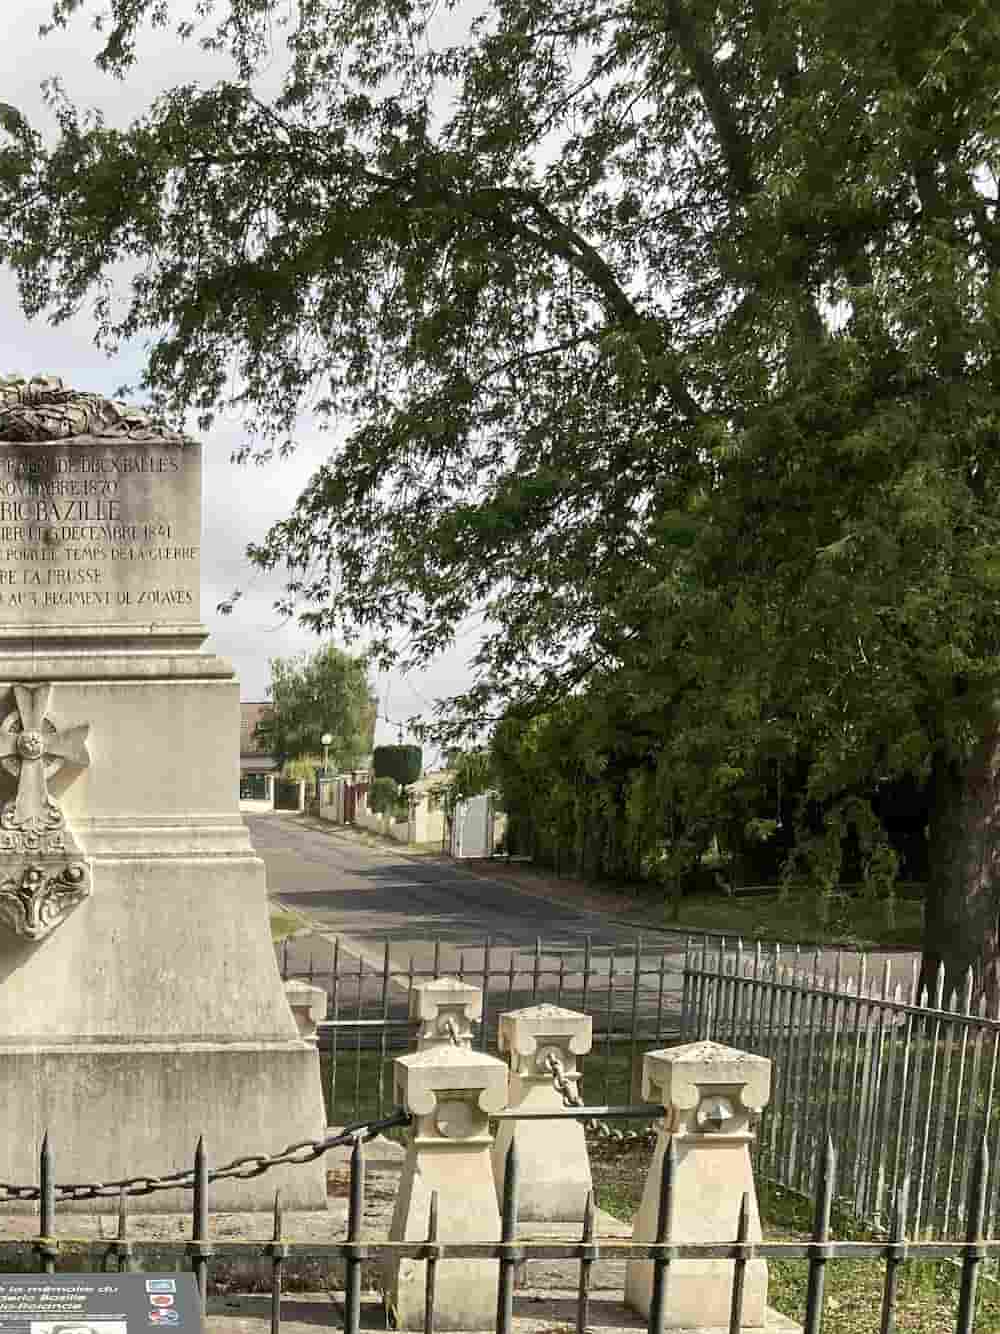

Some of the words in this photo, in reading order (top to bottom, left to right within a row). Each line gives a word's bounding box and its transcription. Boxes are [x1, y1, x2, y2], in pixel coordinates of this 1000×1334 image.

[35, 501, 121, 521] BAZILLE
[47, 567, 106, 585] PRUSSE
[98, 1285, 119, 1295] du
